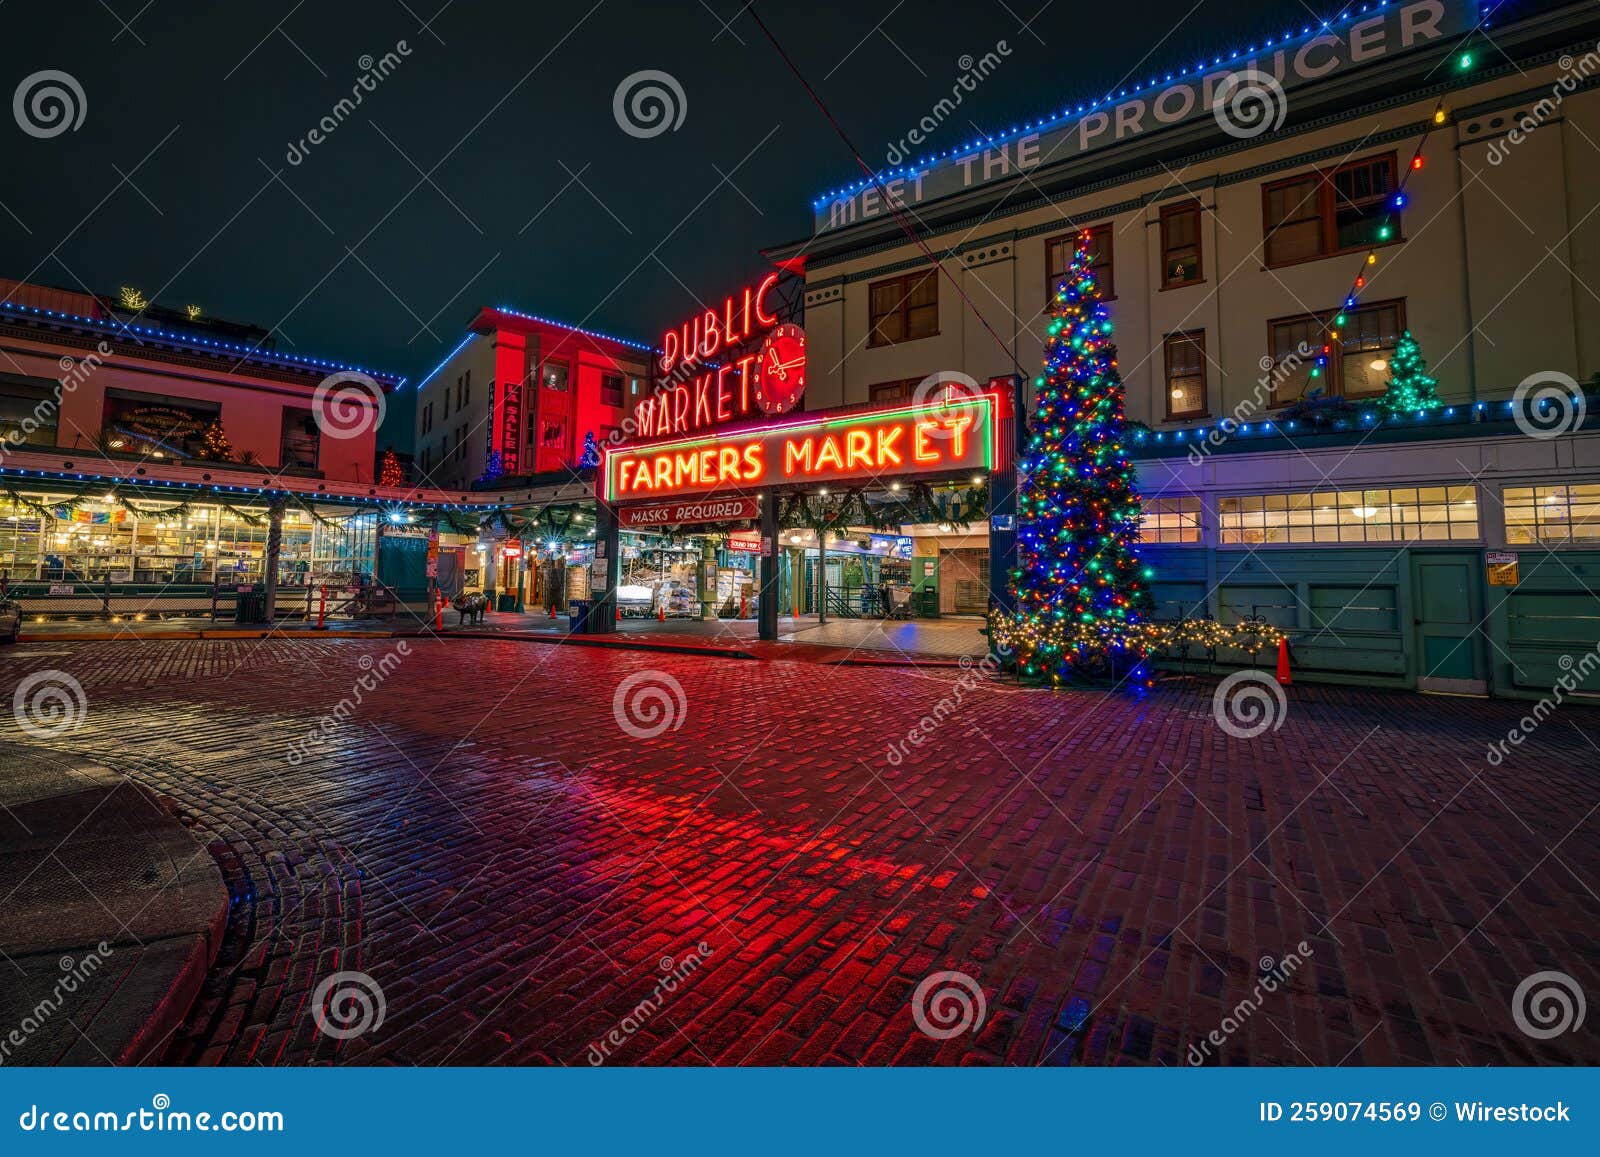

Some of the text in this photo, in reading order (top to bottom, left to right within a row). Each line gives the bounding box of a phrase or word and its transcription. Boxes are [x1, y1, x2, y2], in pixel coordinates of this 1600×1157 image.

[830, 0, 1445, 228] MEET THE PRODUCER
[663, 271, 779, 373] PUBLIC
[777, 327, 784, 336] 12
[791, 328, 795, 336] 1
[765, 338, 771, 347] 11
[800, 337, 805, 346] 2
[757, 354, 764, 363] 10
[754, 374, 759, 382] 9
[799, 377, 803, 385] 4
[507, 384, 519, 402] LA
[637, 353, 755, 438] MARKET
[756, 391, 762, 400] 8
[790, 394, 795, 403] 5
[765, 402, 771, 410] 7
[776, 402, 782, 412] 6
[505, 406, 519, 449] SALLE
[619, 415, 972, 491] FARMERS MARKET
[631, 502, 743, 523] MASKS REQUIRED
